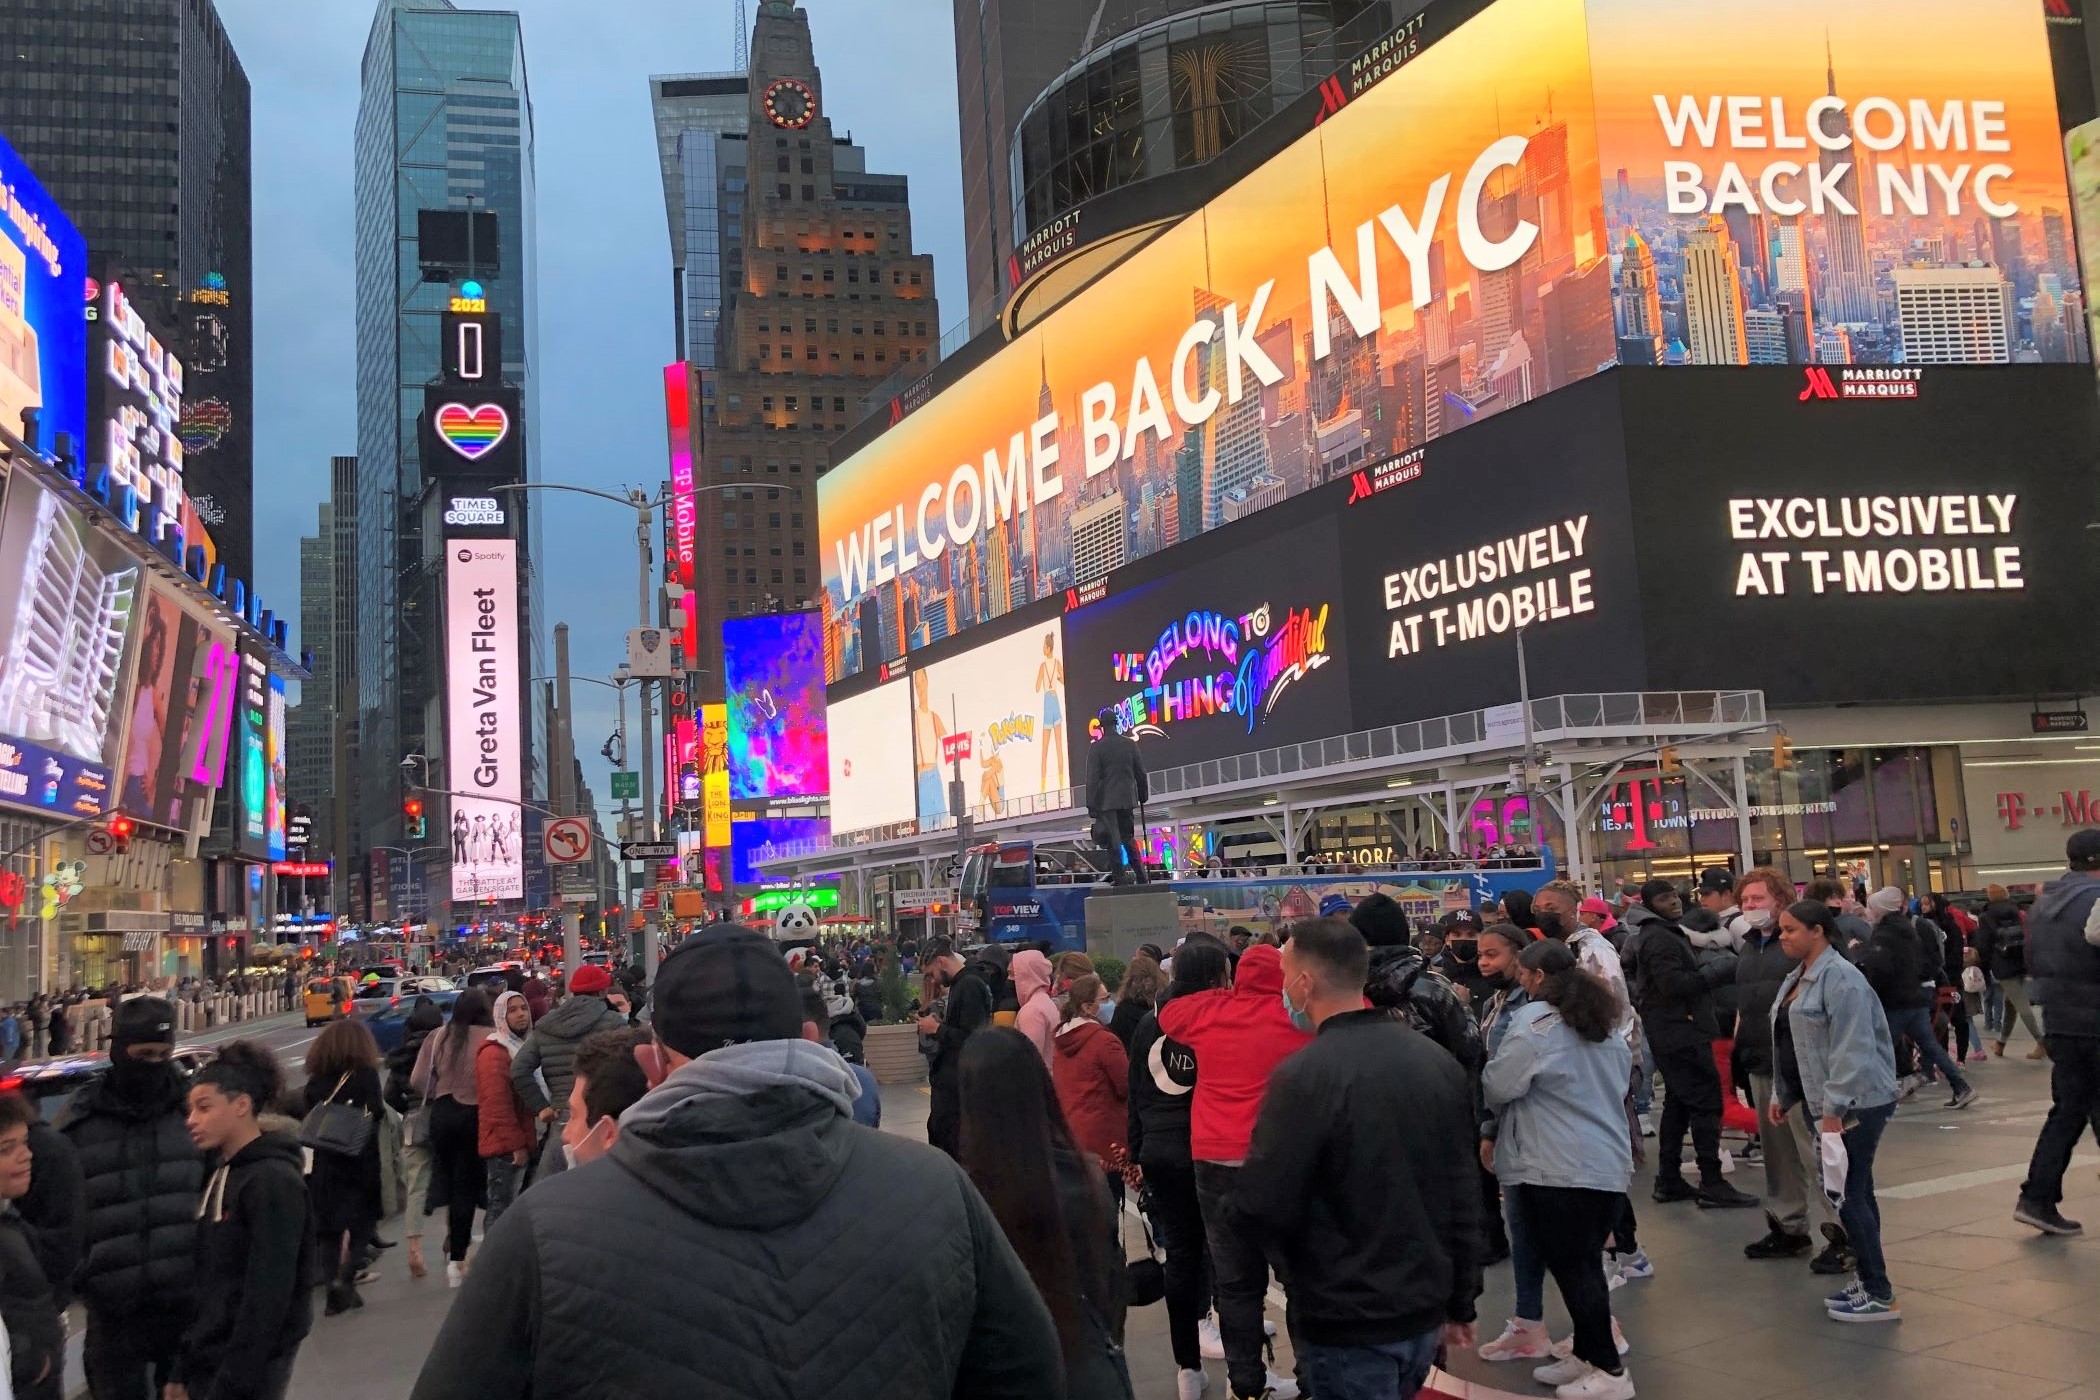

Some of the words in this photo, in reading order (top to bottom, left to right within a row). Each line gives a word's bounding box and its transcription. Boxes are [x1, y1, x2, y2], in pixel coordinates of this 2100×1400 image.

[1352, 13, 1425, 76] MARRIOTT
[1353, 39, 1418, 94] MARQUIS
[1652, 94, 2012, 153] WELCOME
[1664, 160, 1859, 217] BACK
[1876, 163, 2020, 218] NYC
[1023, 210, 1081, 257] MARRIOTT
[1024, 232, 1074, 273] MARQUIS
[451, 298, 486, 313] 2021
[835, 411, 1064, 603] WELCOME
[1081, 278, 1286, 479] BACK
[1308, 135, 1540, 361] NYC
[1842, 368, 1923, 381] MARRIOTT
[903, 373, 934, 401] MARRIOTT
[1843, 384, 1917, 397] MARQUIS
[904, 388, 931, 413] MARQUIS
[1374, 449, 1425, 477] MARRIOTT
[1375, 465, 1420, 490] MARQUIS
[447, 511, 503, 523] SQUARE
[454, 500, 497, 511] TIMES
[1729, 494, 2017, 540] EXCLUSIVELY
[474, 551, 506, 563] Spotify
[1384, 515, 1589, 610] EXCLUSIVELY
[1736, 552, 1790, 596] AT
[1801, 546, 2025, 594] T-MOBILE
[1079, 576, 1109, 595] MARRIOTT
[1080, 588, 1106, 604] MARQUIS
[471, 587, 496, 652] Fleet
[1389, 615, 1423, 659] AT
[1429, 568, 1595, 647] T-MOBILE
[1113, 653, 1145, 682] WE
[1146, 608, 1239, 692] BELONG
[1239, 601, 1271, 642] TO
[472, 661, 498, 709] Van
[1088, 671, 1236, 741] SMETHING
[473, 712, 499, 788] Greta
[708, 800, 726, 809] LION
[710, 791, 723, 799] THE
[707, 811, 730, 823] KING
[629, 847, 645, 855] ONE
[653, 846, 671, 854] WAY
[1317, 846, 1394, 865] EPHORA
[455, 885, 497, 895] GAREN'S
[993, 904, 1040, 916] TOPVIEW
[1456, 910, 1469, 921] NY
[1006, 924, 1020, 933] 349
[1169, 1051, 1195, 1071] ND
